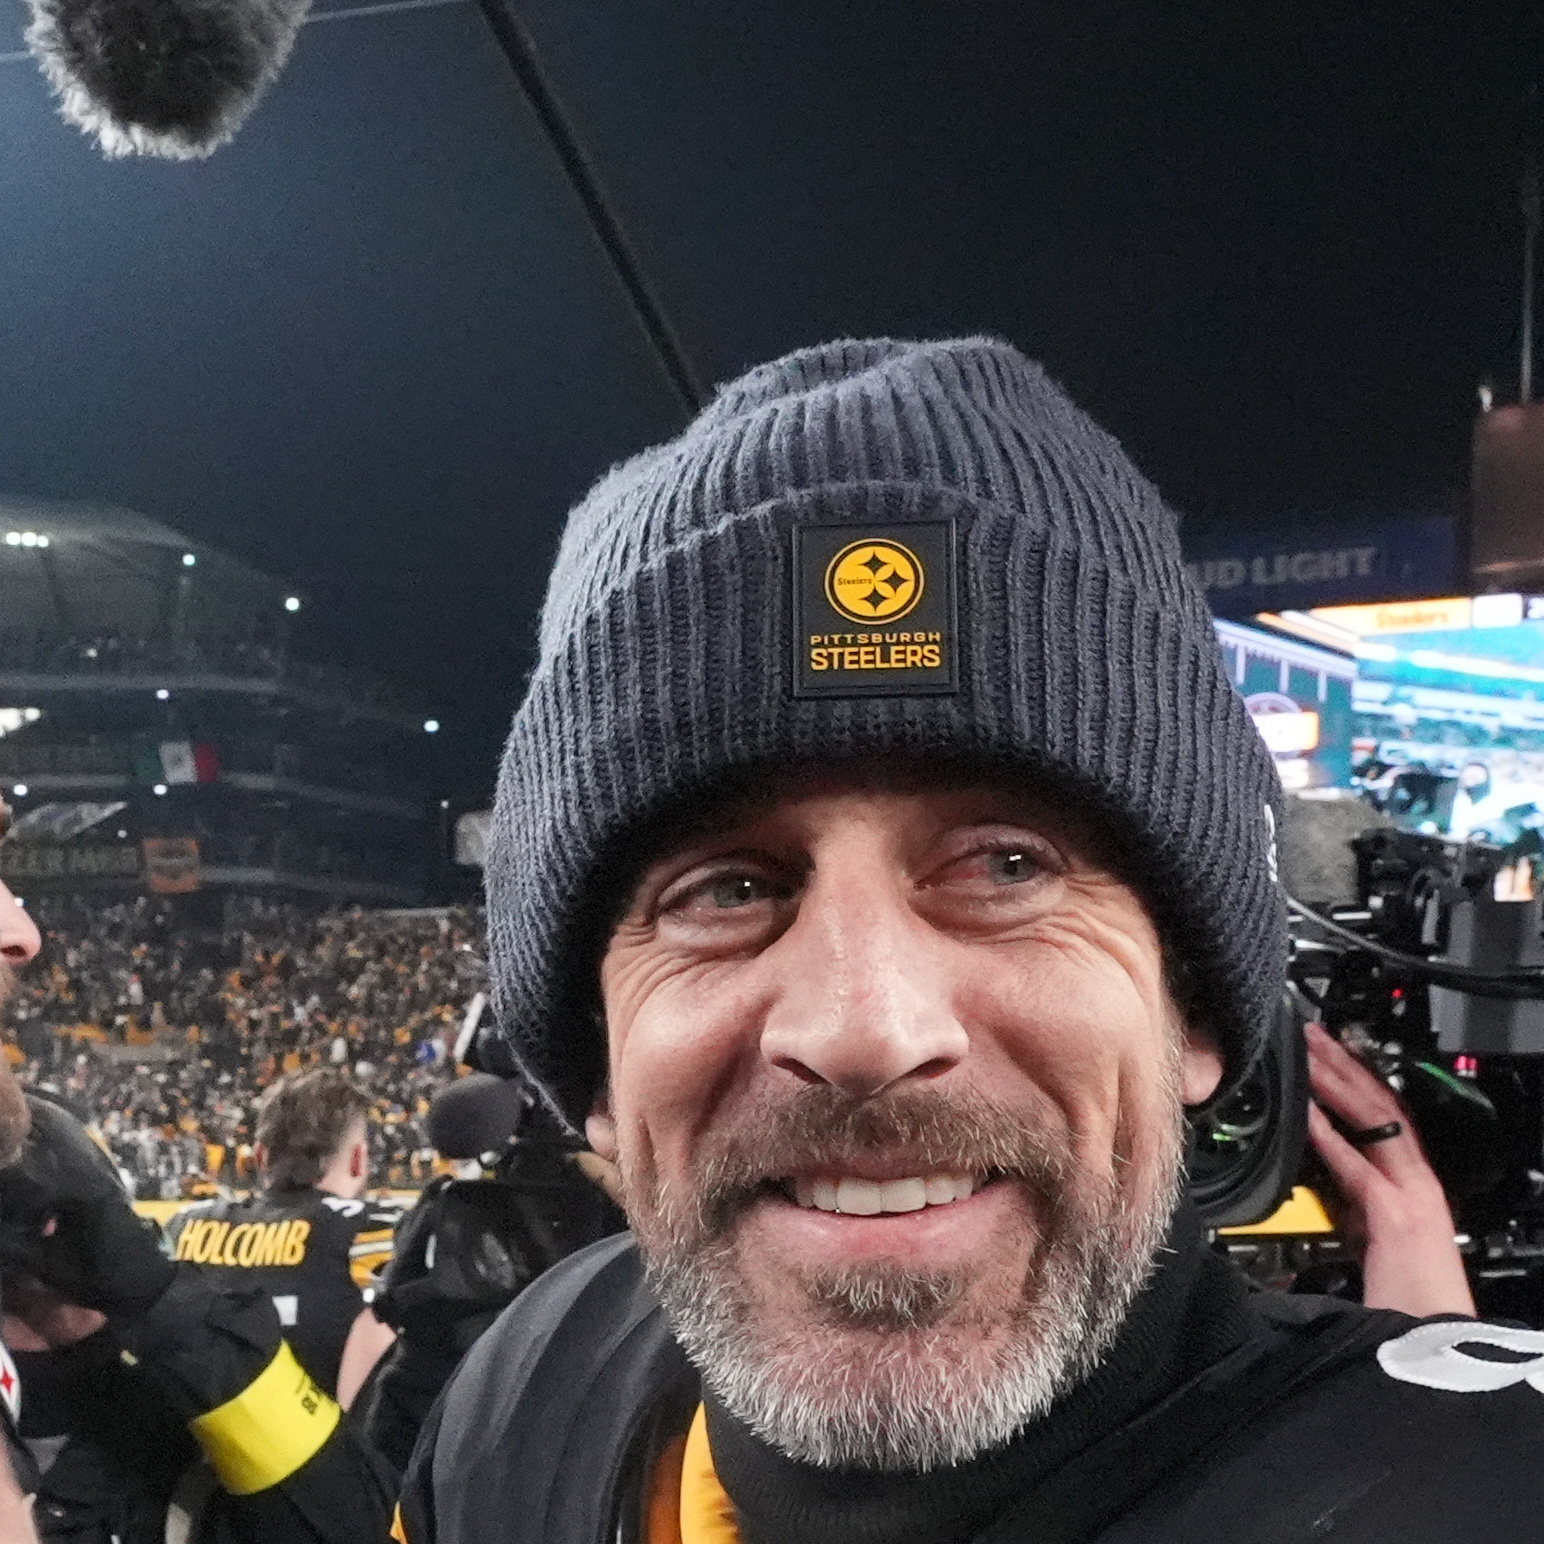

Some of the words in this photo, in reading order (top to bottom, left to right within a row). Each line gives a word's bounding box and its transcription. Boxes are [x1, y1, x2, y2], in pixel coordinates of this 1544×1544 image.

[1252, 546, 1377, 586] LIGHT
[837, 577, 872, 586] Steelers
[810, 632, 941, 646] PITTSBURGH
[811, 645, 941, 671] STEELERS
[175, 1217, 312, 1268] HOLCOMB
